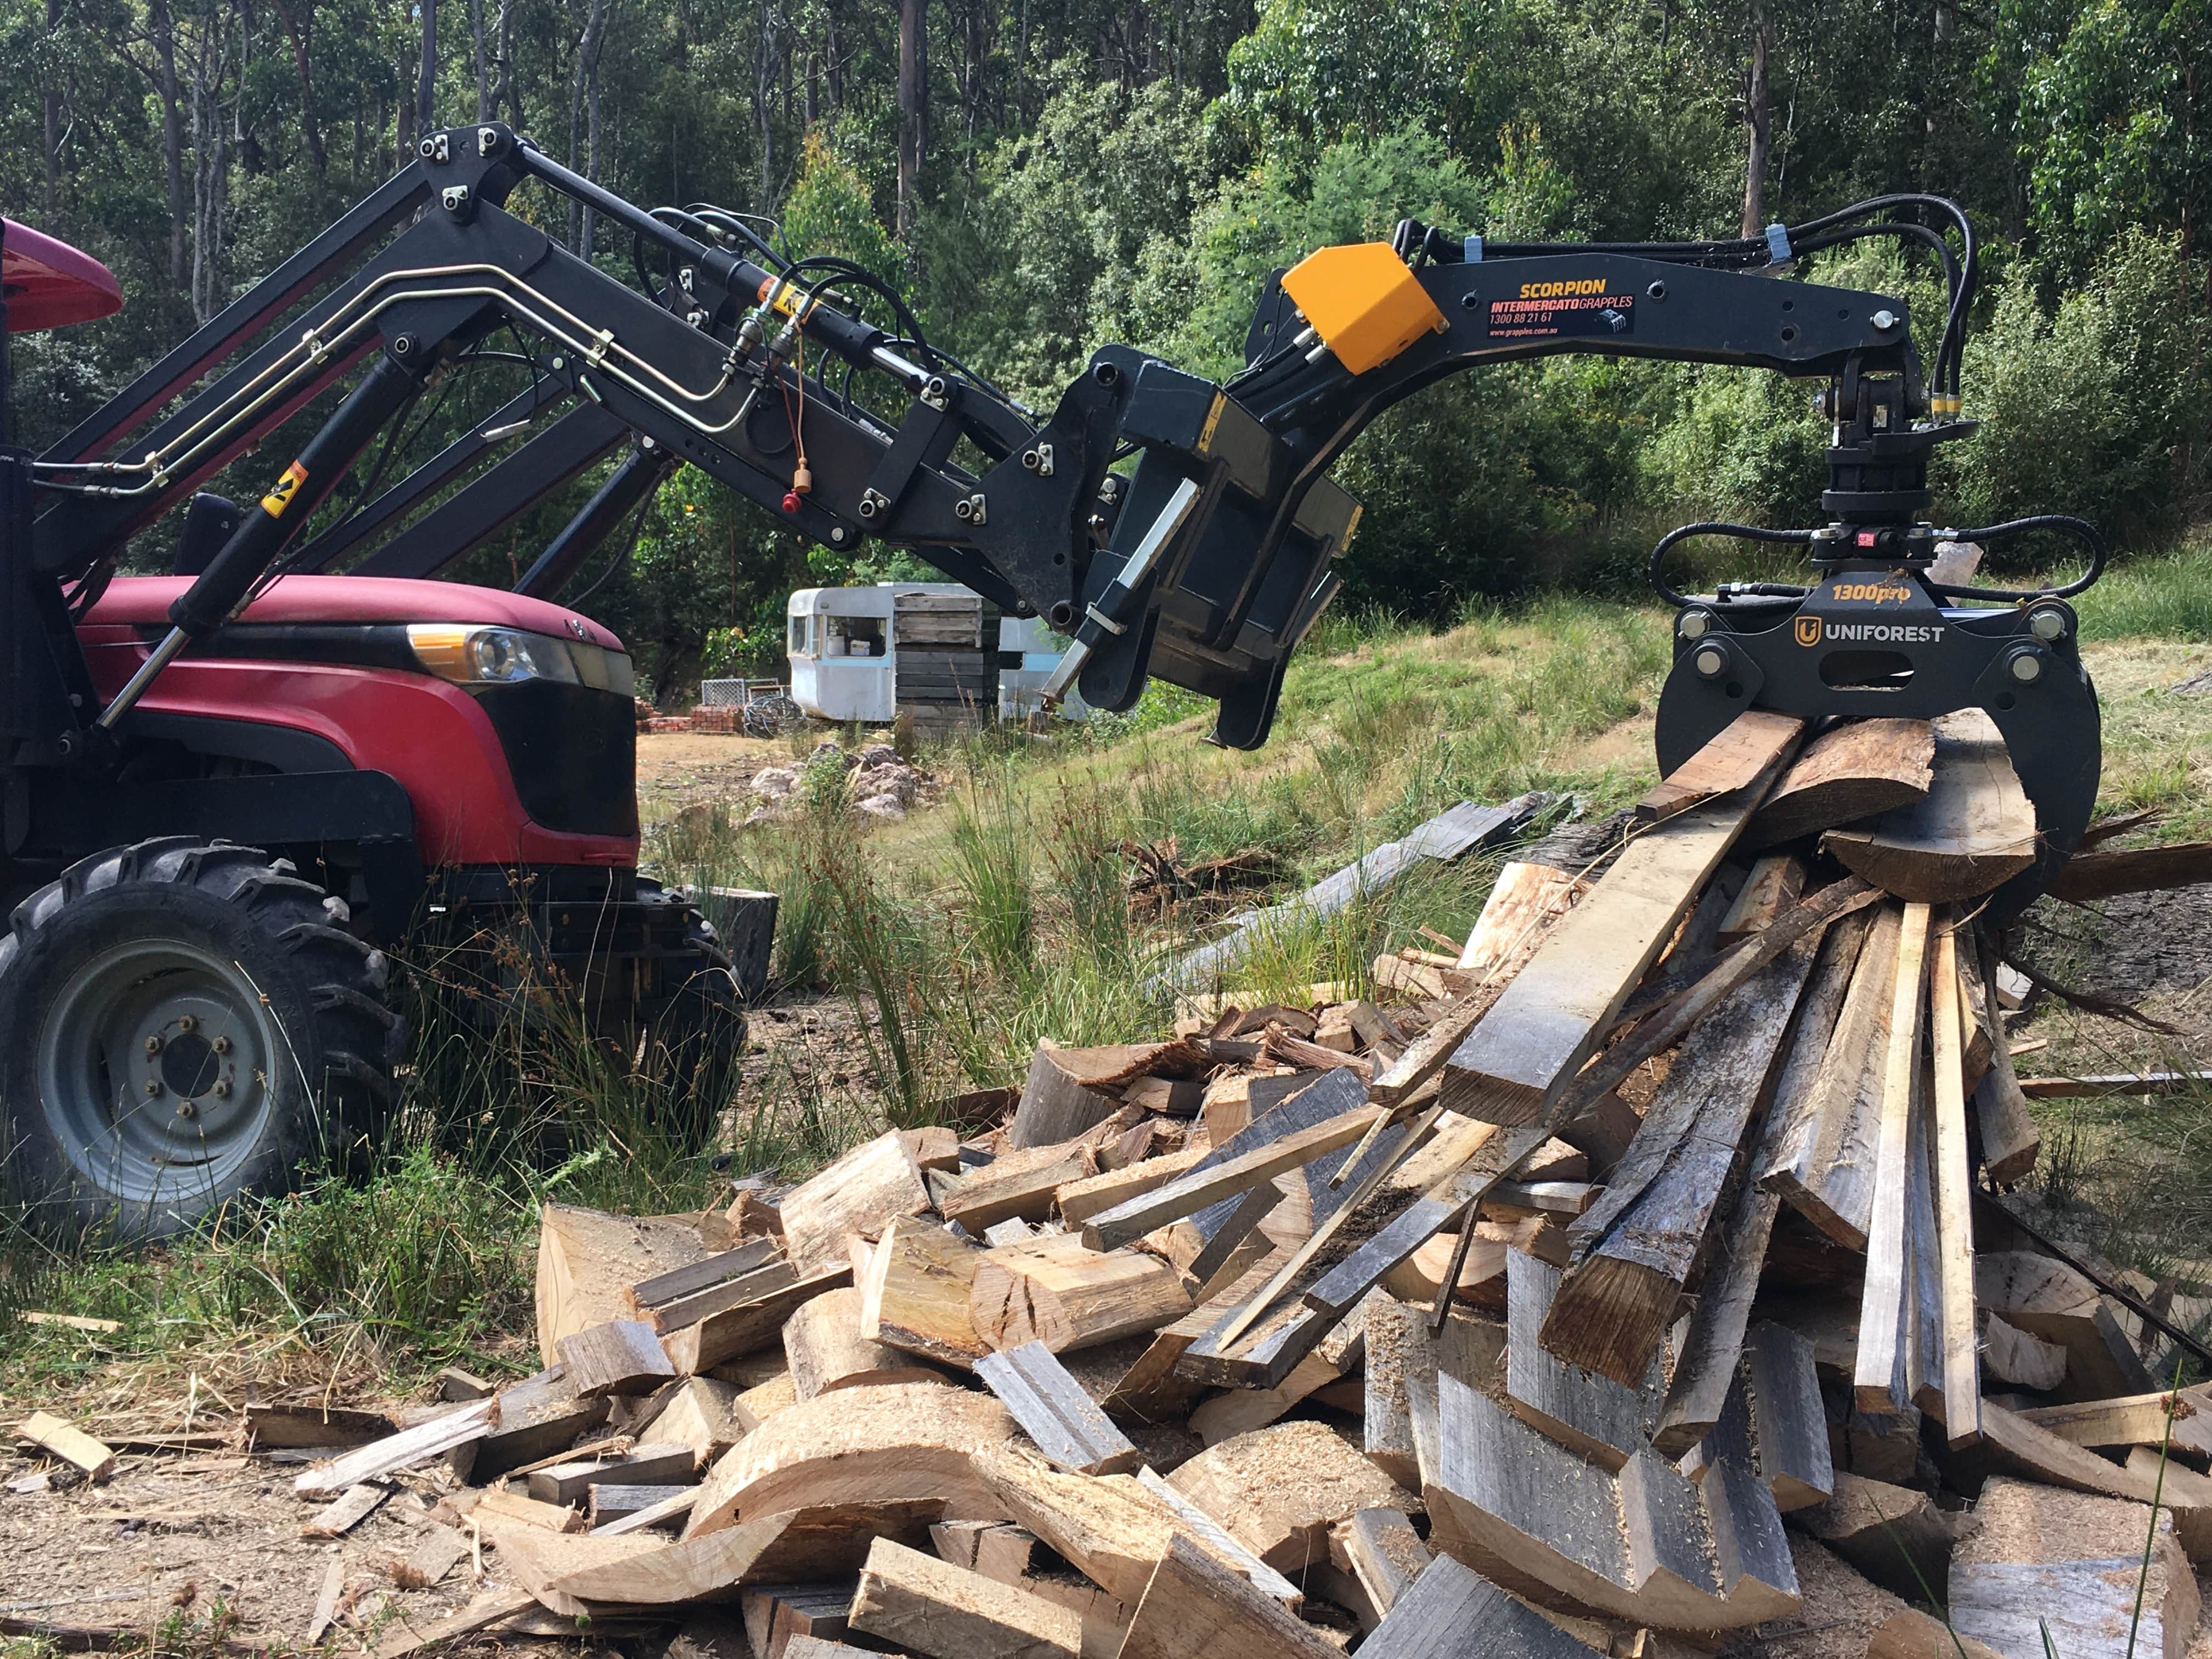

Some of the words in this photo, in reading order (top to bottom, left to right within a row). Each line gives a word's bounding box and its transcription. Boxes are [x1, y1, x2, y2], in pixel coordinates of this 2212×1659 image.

[1519, 279, 1606, 298] SCORPION
[1490, 314, 1512, 325] 1300
[1513, 313, 1525, 324] 88
[1527, 313, 1538, 323] 21
[1541, 312, 1552, 323] 61
[1489, 328, 1558, 337] www.grapples.com.au
[1833, 584, 1911, 605] 1300pro
[1826, 624, 1945, 642] UNIFOREST
